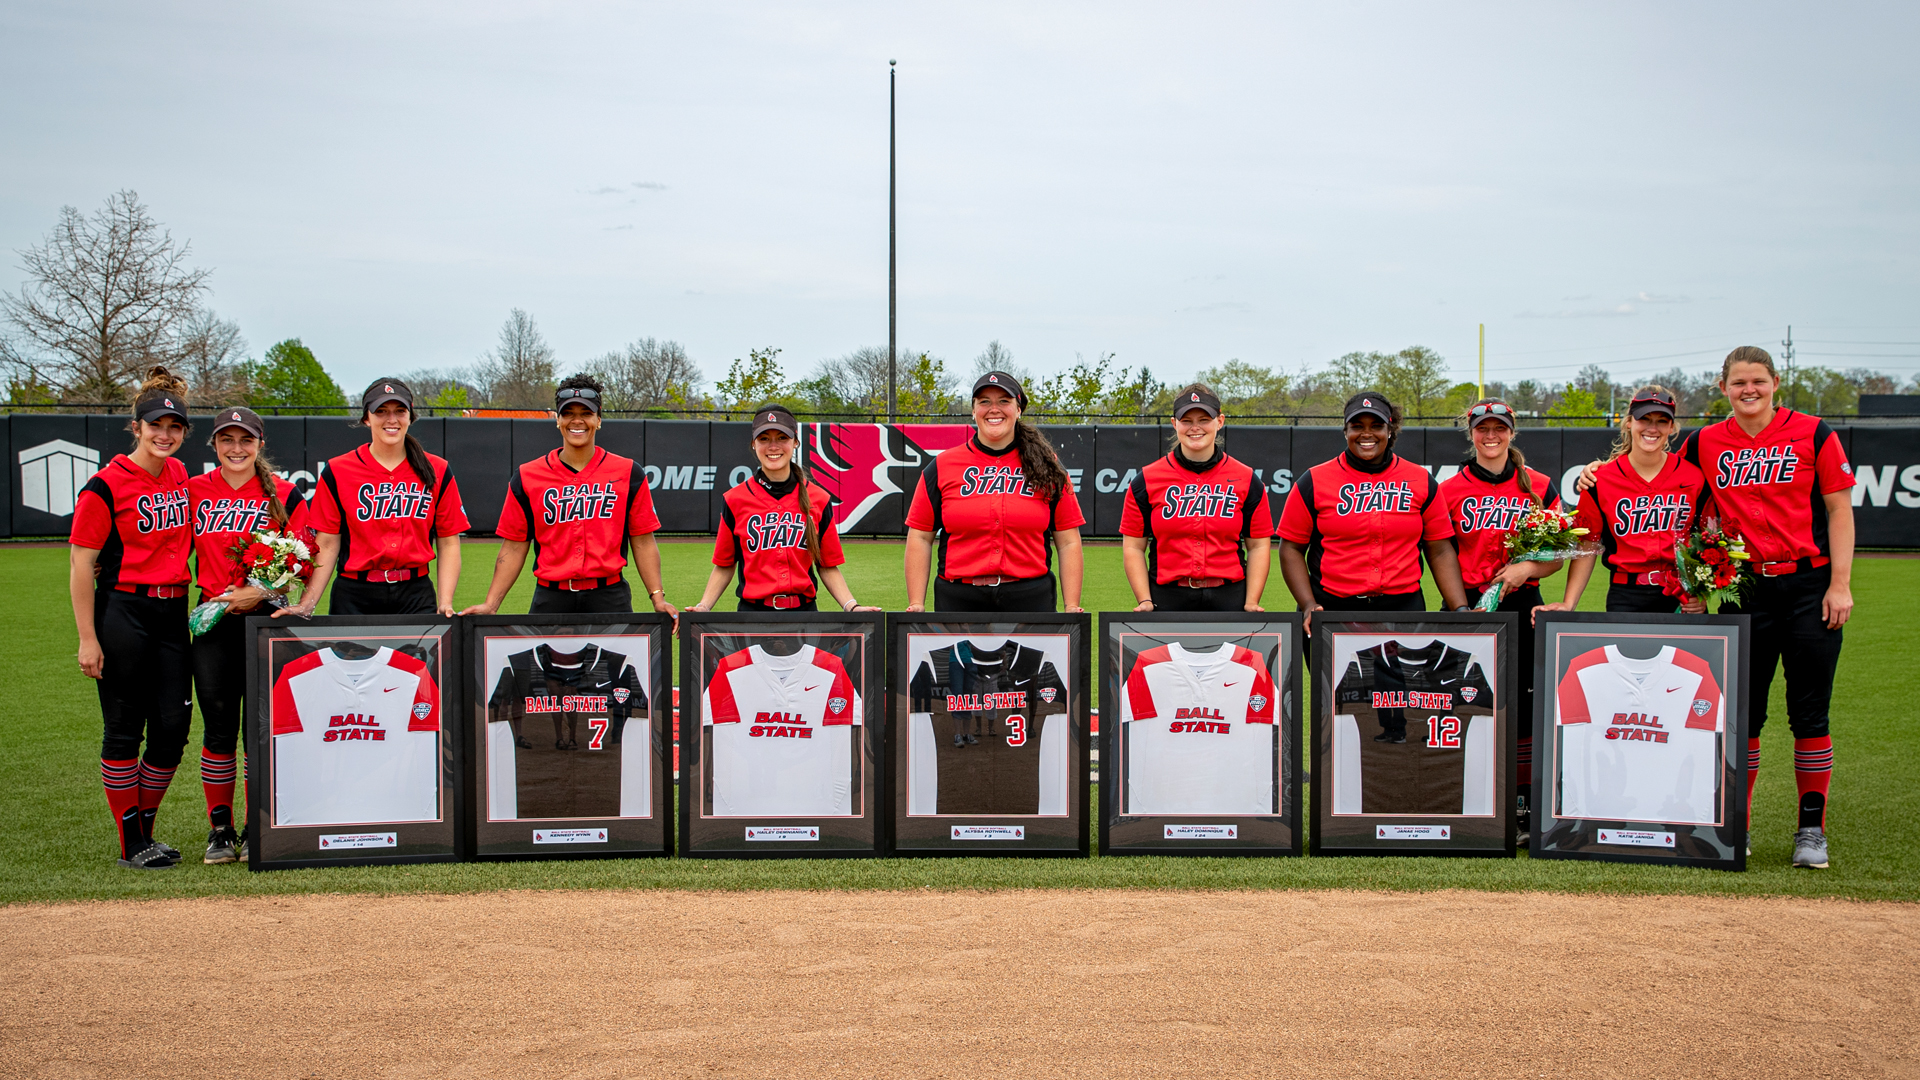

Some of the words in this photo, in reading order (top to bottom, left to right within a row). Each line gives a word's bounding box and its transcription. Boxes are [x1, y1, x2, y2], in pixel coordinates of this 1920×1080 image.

[1738, 445, 1796, 461] BALL
[643, 465, 717, 490] OME
[984, 466, 1022, 475] BAL
[1716, 450, 1799, 489] STATE
[562, 483, 615, 497] BALL
[1184, 484, 1237, 496] BALL
[1359, 481, 1411, 492] BALL
[215, 498, 270, 511] BALL
[357, 483, 433, 522] STATE
[543, 487, 618, 525] STATE
[1162, 485, 1238, 520] STATE
[1337, 483, 1413, 516] STATE
[1481, 496, 1531, 509] BALL
[1636, 494, 1691, 509] BALL
[194, 499, 271, 536] STATE
[765, 511, 806, 525] BAL
[1614, 497, 1692, 537] STATE
[525, 695, 561, 714] BALL
[562, 695, 608, 713] STATE
[947, 694, 982, 711] BALL
[983, 691, 1026, 710] STATE
[1372, 691, 1408, 708] BALL
[1408, 691, 1452, 710] STATE
[329, 713, 380, 727] BALL
[754, 711, 807, 725] BALL
[1175, 706, 1225, 720] BALL
[1611, 713, 1663, 729] BALL
[323, 728, 386, 742] STATE
[588, 718, 609, 750] 7
[748, 725, 813, 739] STATE
[1005, 714, 1027, 747] 3
[1169, 721, 1231, 734] STATE
[1426, 715, 1461, 748] 12
[1604, 727, 1669, 744] STATE
